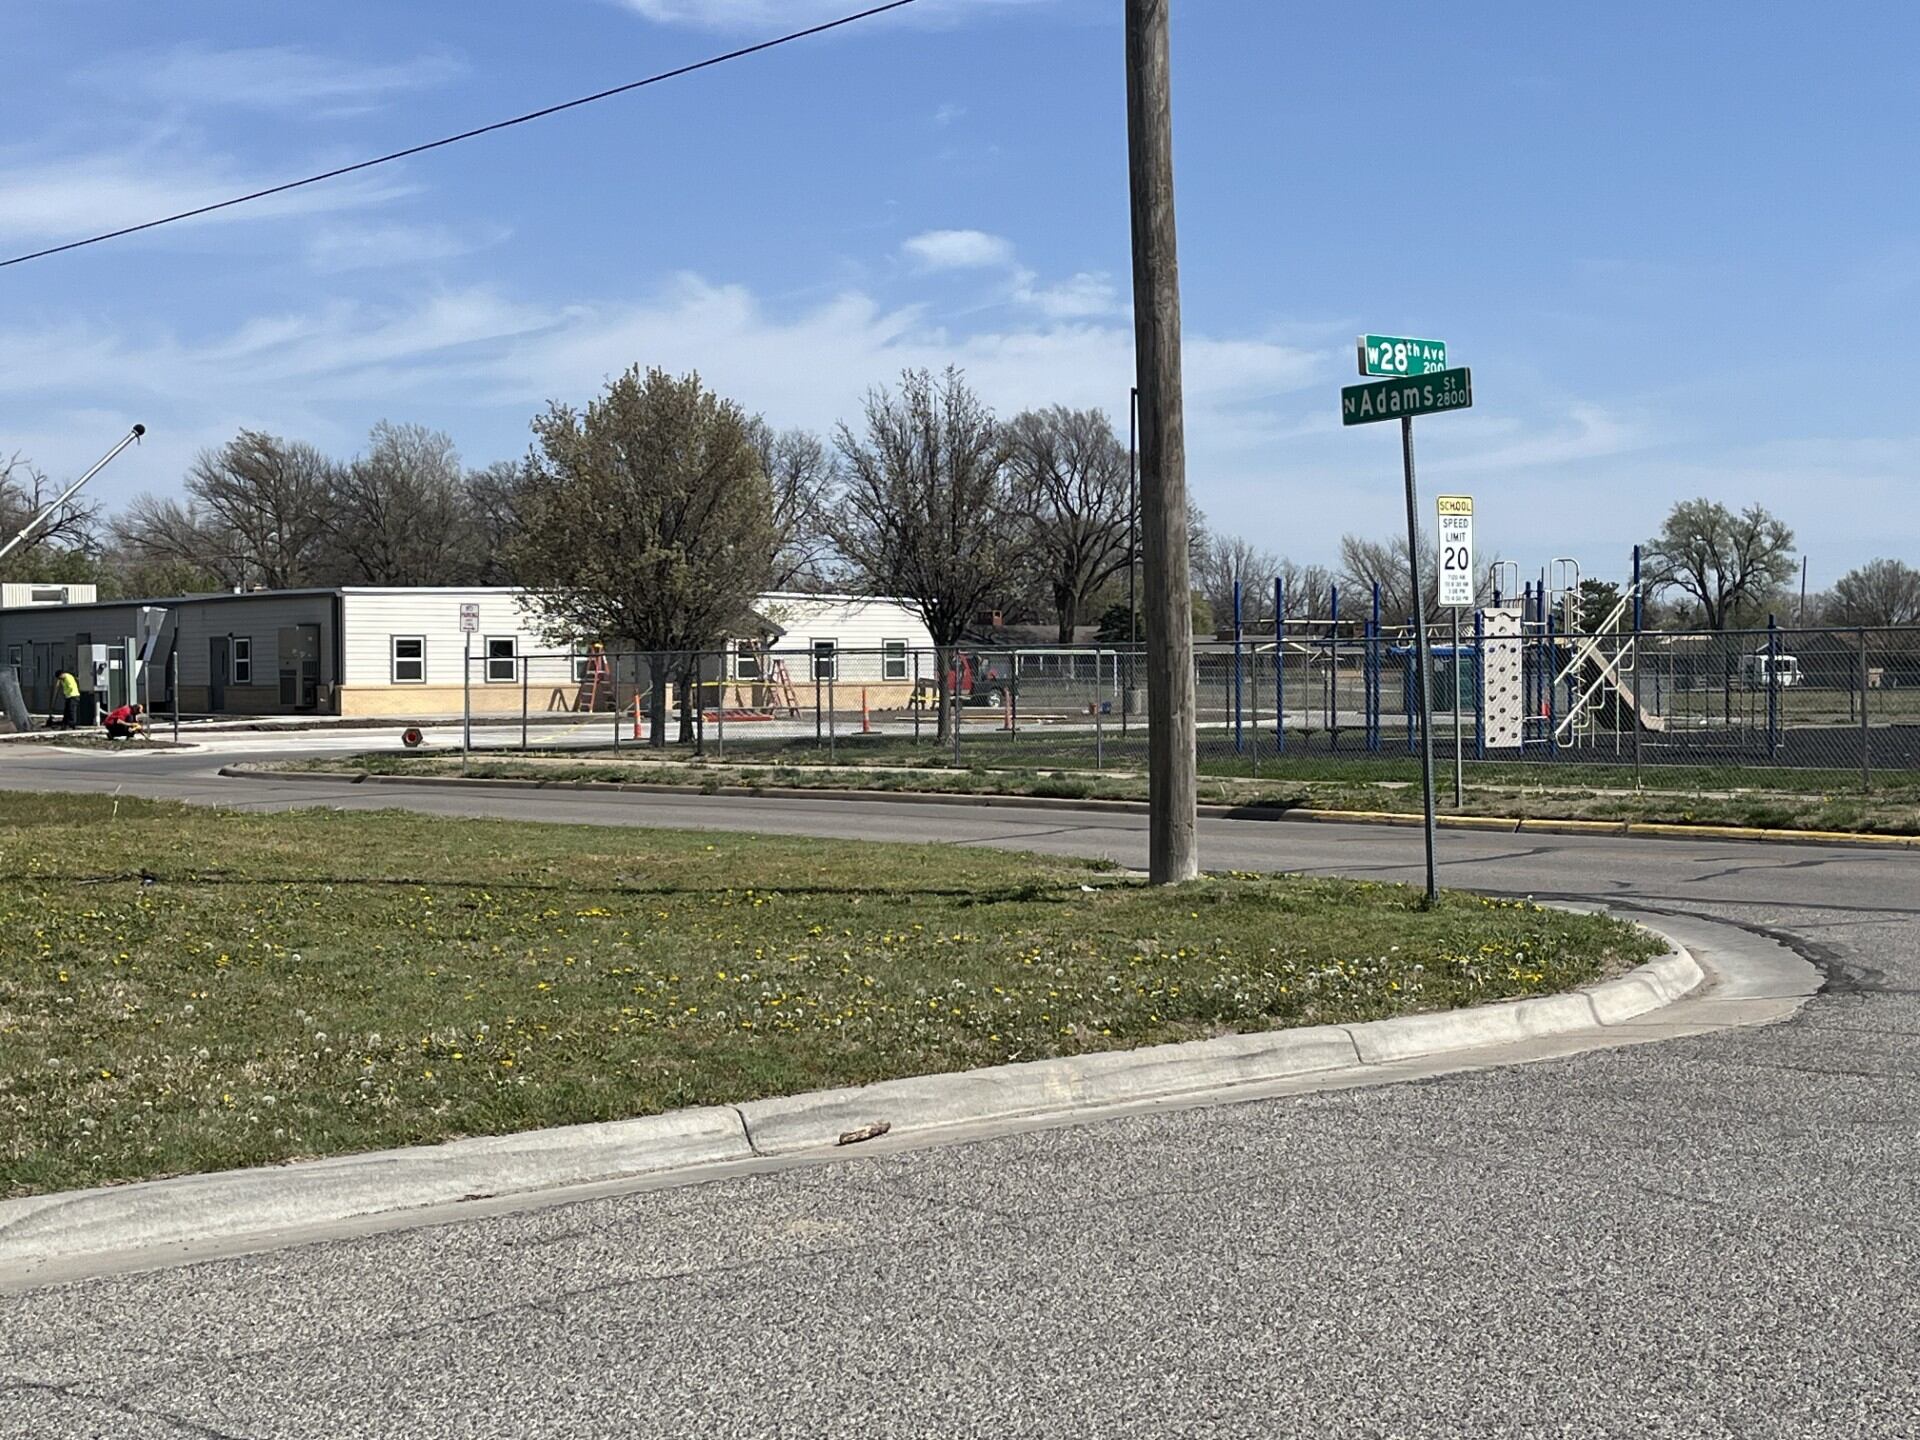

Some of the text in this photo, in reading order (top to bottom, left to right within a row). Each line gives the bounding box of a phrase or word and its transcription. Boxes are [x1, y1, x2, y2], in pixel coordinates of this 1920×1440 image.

[1368, 342, 1444, 372] W 28th Ave
[1423, 362, 1444, 374] 200
[1344, 376, 1456, 417] N Adams St
[1436, 389, 1465, 407] 2800
[1440, 501, 1471, 511] SCHOOL
[1443, 518, 1469, 528] SPEED
[1445, 532, 1466, 542] LIMIT
[1444, 546, 1469, 570] 20
